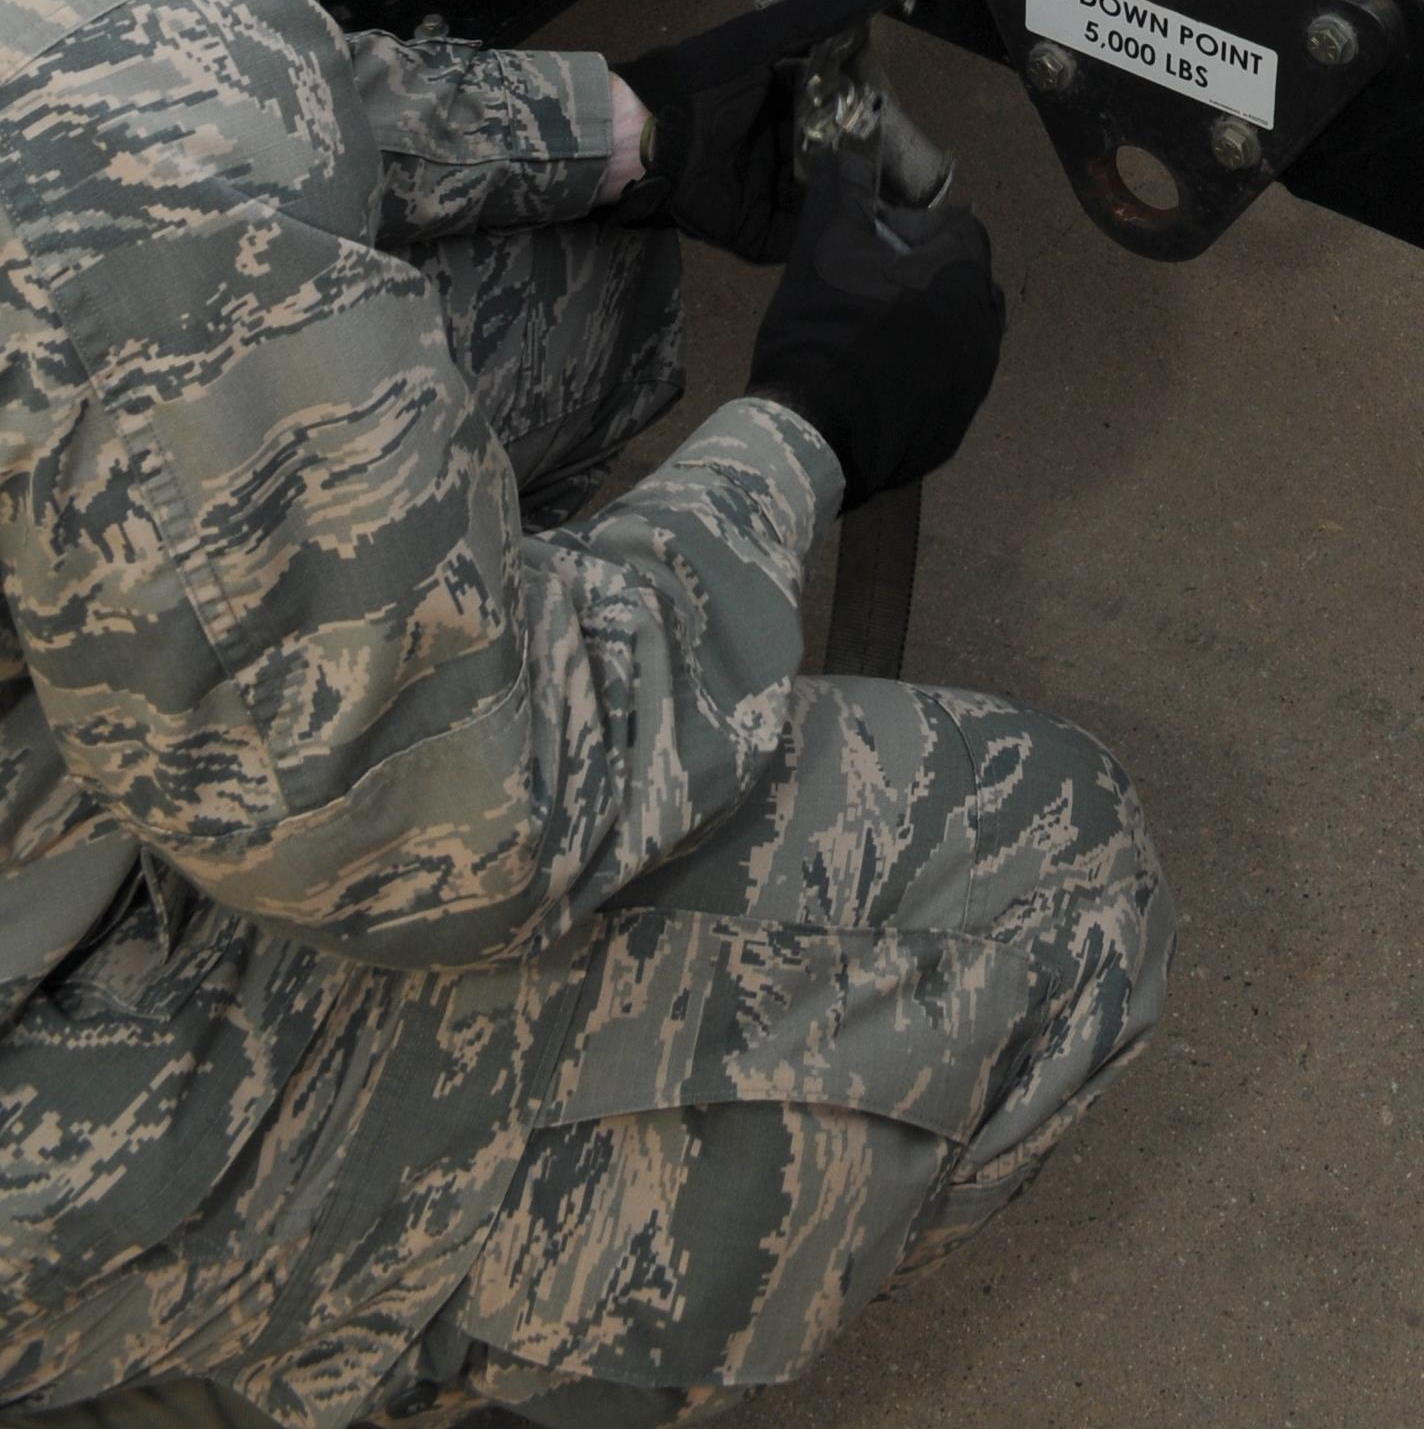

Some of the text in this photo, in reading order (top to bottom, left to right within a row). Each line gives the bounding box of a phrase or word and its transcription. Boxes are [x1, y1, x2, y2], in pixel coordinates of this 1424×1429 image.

[1082, 19, 1210, 90] 5,000 LBS
[1178, 23, 1264, 76] POINT
